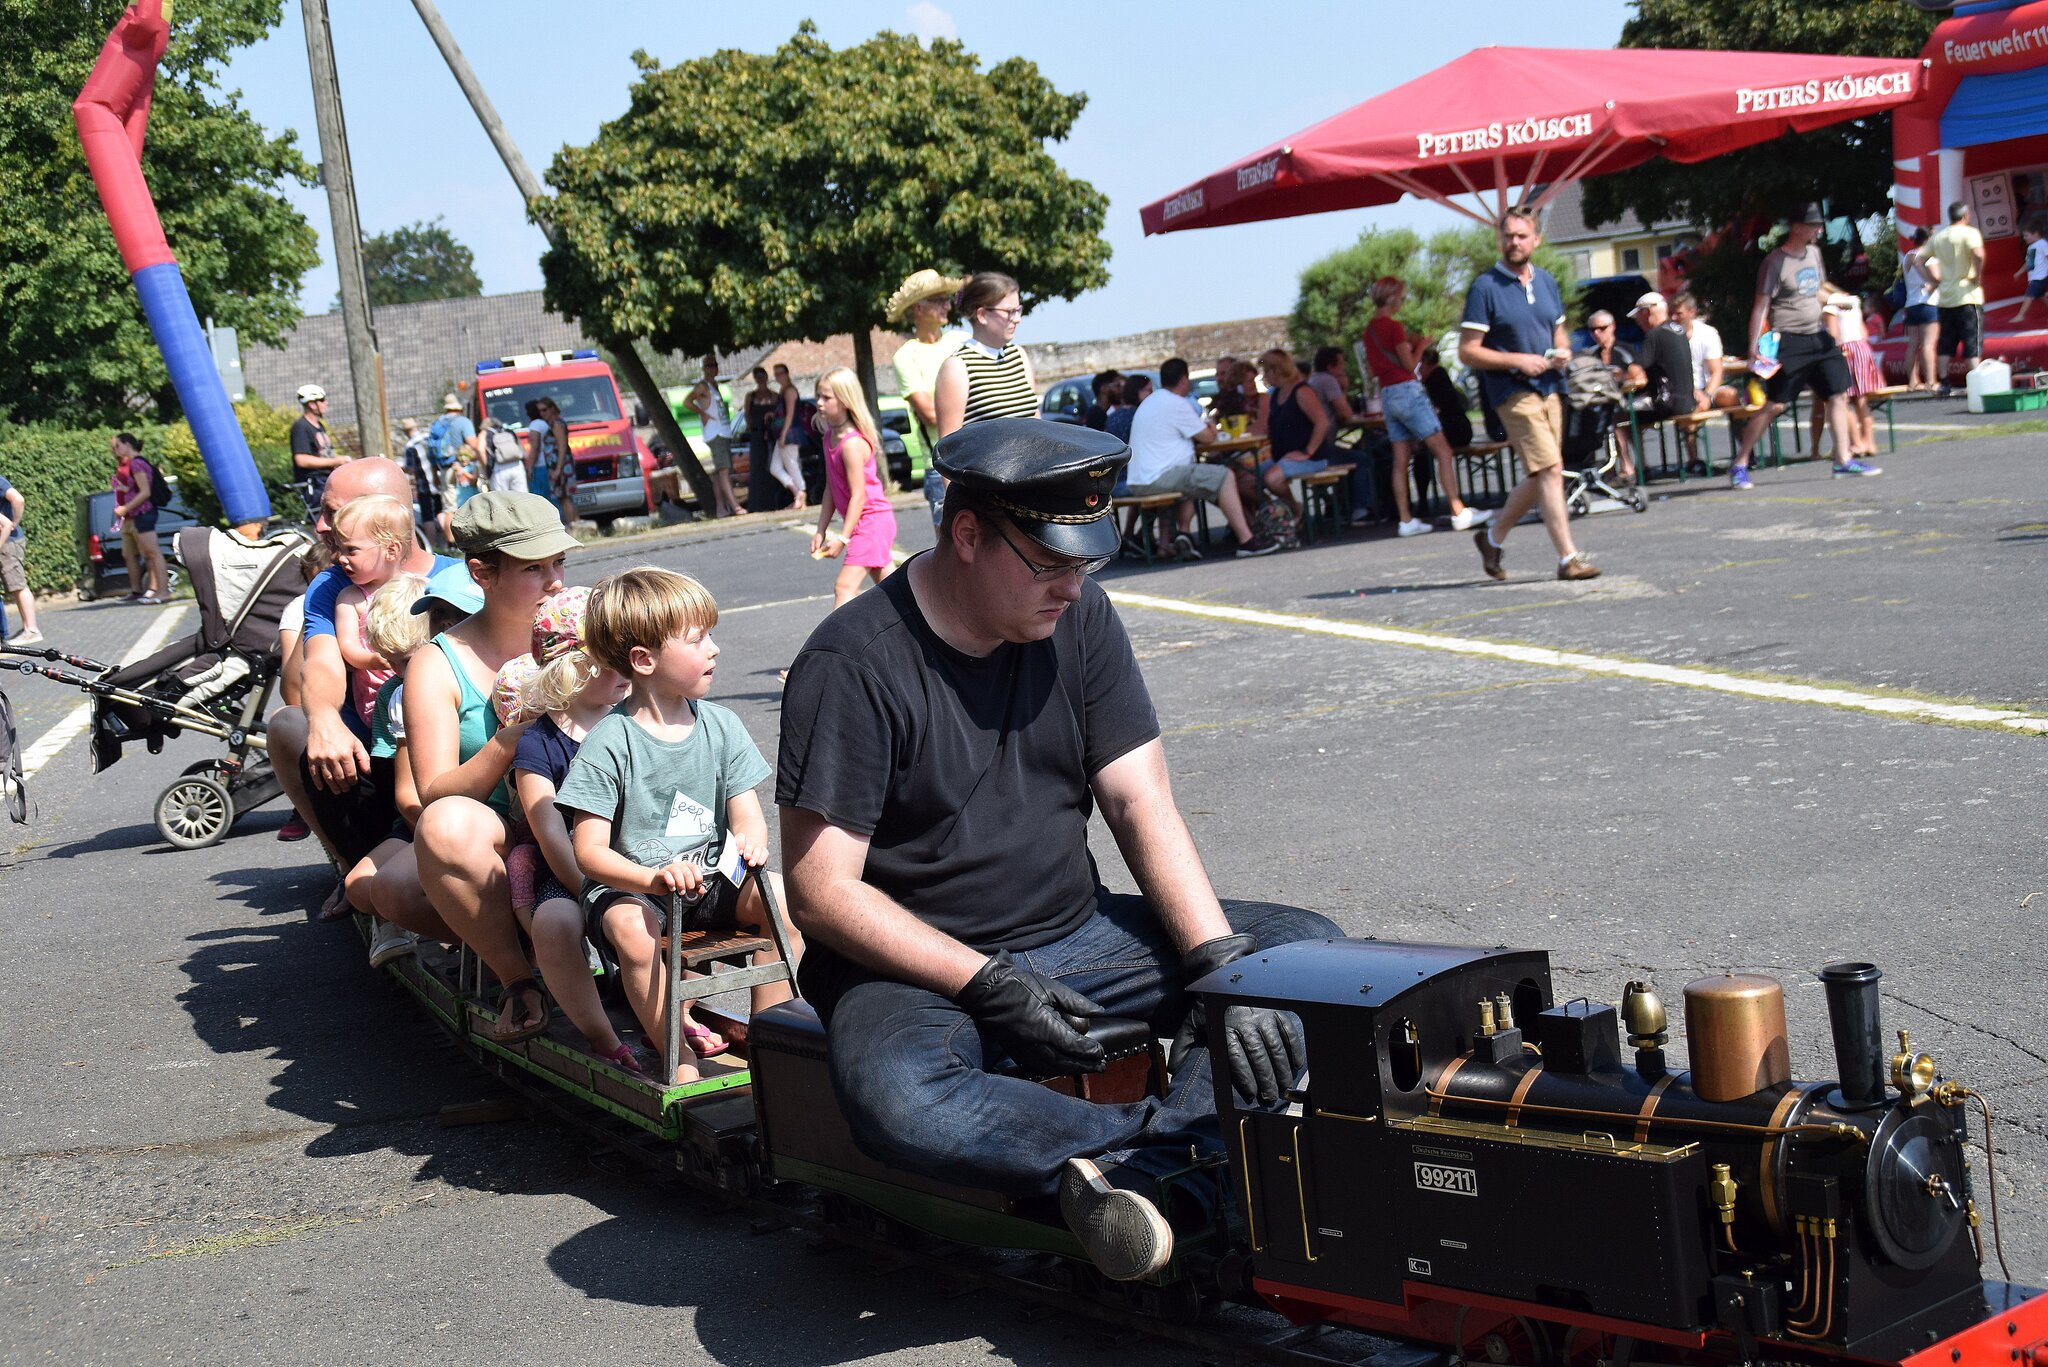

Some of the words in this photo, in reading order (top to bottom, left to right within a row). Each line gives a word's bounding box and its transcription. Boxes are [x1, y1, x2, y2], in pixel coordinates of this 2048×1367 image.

[1944, 25, 2048, 64] Feuerwehr11
[1735, 79, 1819, 114] PETERS
[1822, 70, 1912, 103] KÖLSCH
[1416, 121, 1502, 158] PETERS
[1505, 112, 1593, 146] KÖLSCH
[670, 799, 704, 821] beep
[1421, 1166, 1471, 1191] 99211
